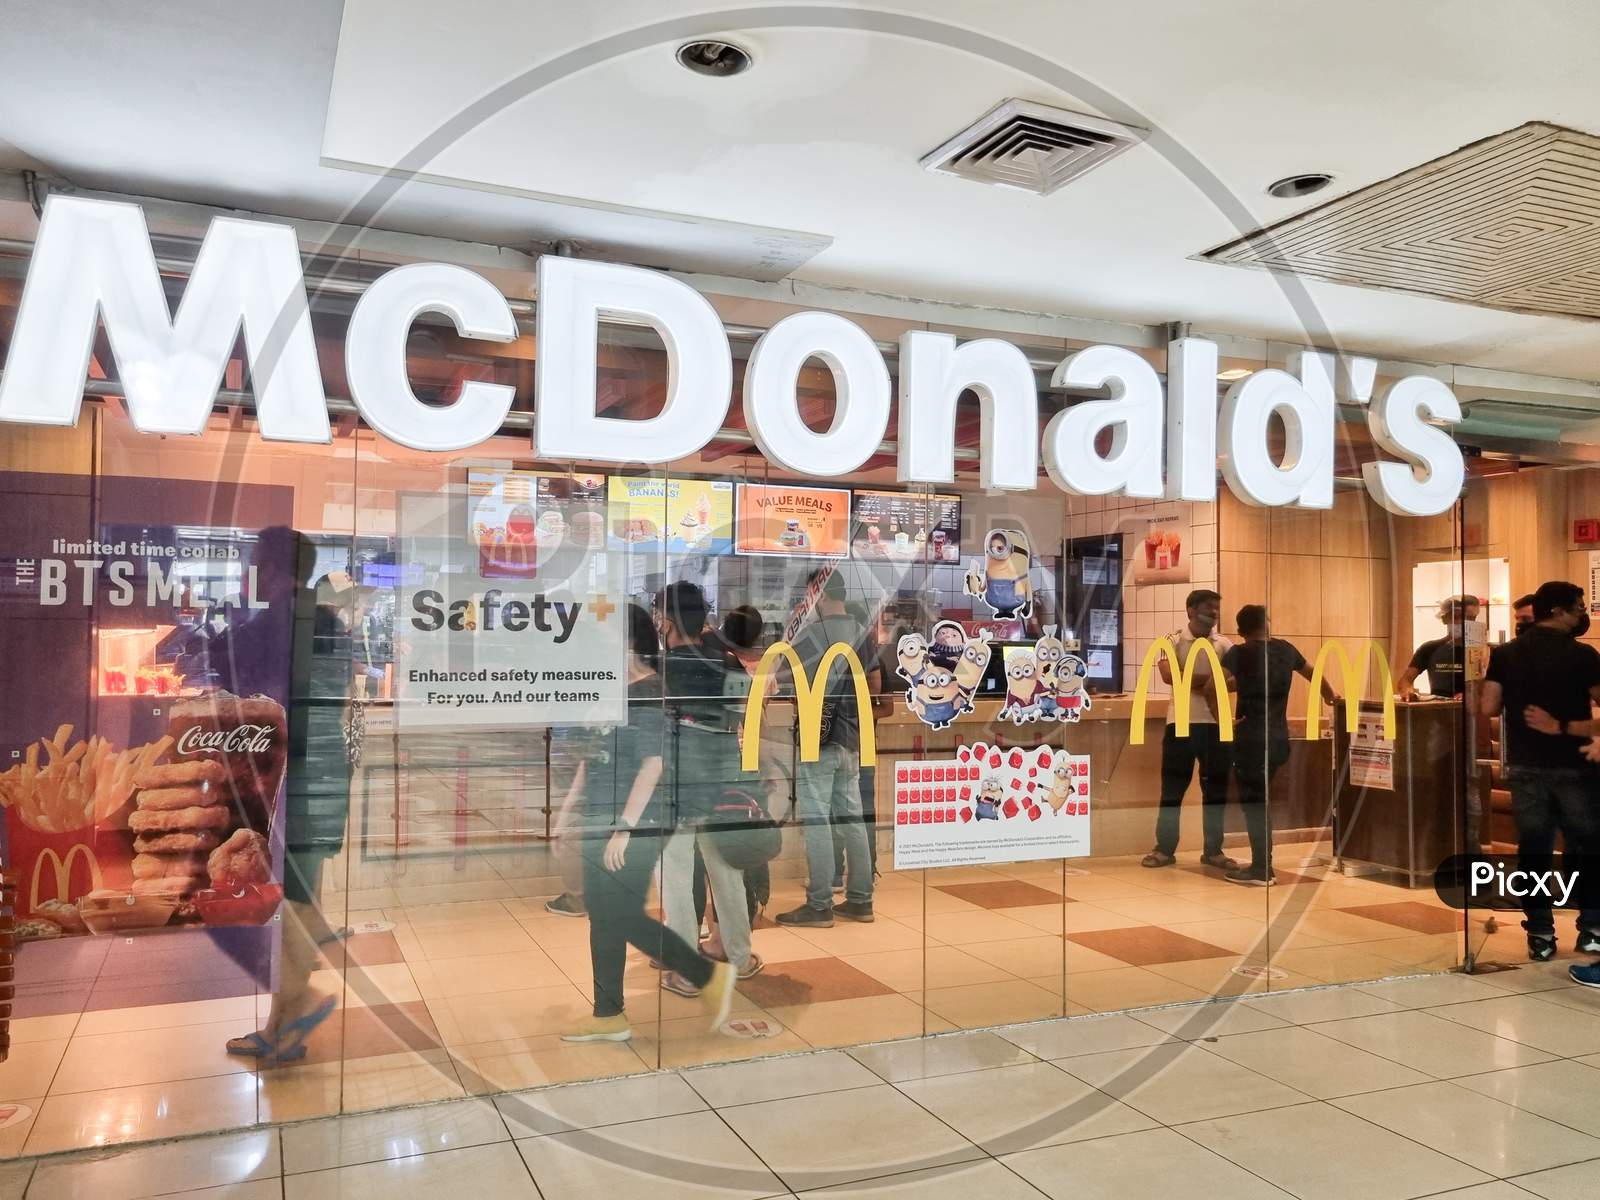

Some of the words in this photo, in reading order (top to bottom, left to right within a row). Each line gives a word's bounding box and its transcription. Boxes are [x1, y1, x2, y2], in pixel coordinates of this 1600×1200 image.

[0, 194, 1466, 517] McDonald's
[628, 488, 679, 498] BANANS!
[756, 495, 793, 508] VALUE
[795, 496, 833, 512] MEALS
[53, 540, 127, 556] limited
[131, 541, 177, 557] time
[181, 544, 240, 560] collab
[16, 558, 35, 586] THE
[40, 559, 135, 607] BTS
[147, 561, 270, 609] MEAL
[409, 669, 487, 683] Enhanced
[491, 668, 538, 685] safety
[542, 669, 617, 681] measures.
[427, 691, 452, 705] For
[456, 691, 489, 708] you.
[492, 690, 524, 704] And
[526, 692, 551, 703] our
[554, 689, 600, 702] teams
[177, 724, 275, 755] Coca-Cola
